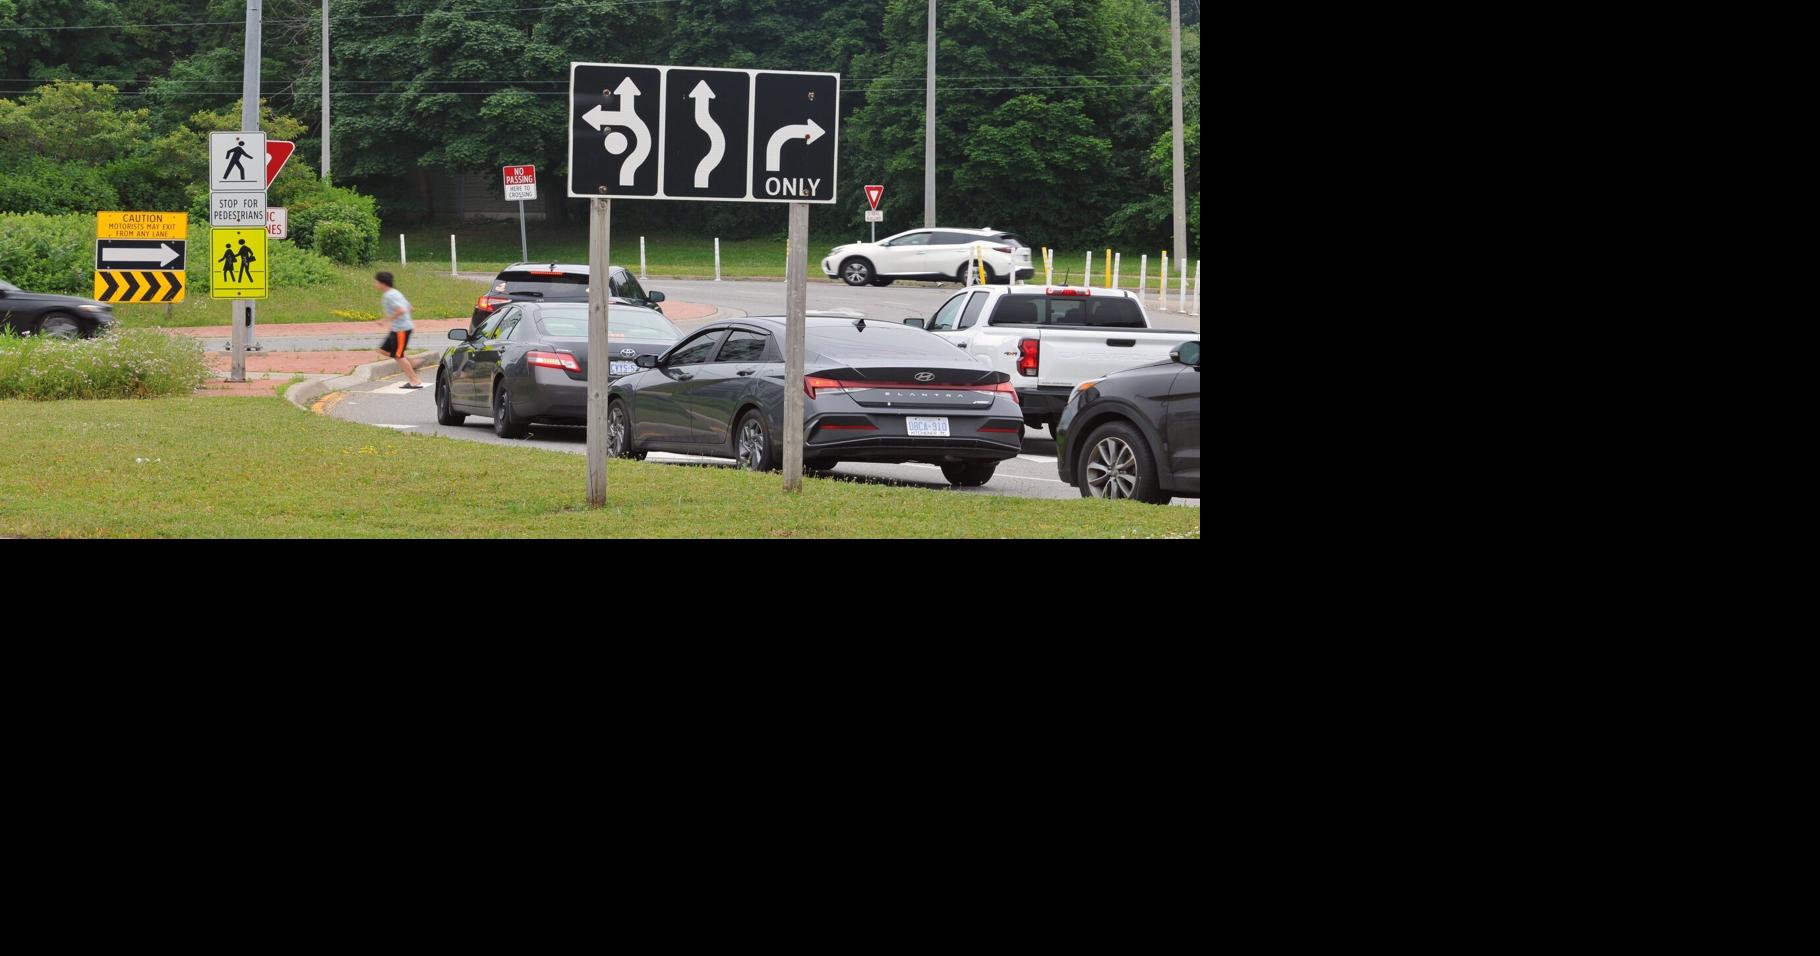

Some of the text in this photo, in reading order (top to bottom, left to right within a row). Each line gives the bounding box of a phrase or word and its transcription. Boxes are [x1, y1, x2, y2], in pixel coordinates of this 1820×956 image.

[513, 167, 524, 175] NO
[506, 175, 533, 184] PASSING
[765, 176, 821, 197] ONLY
[219, 199, 258, 208] STOP FOR
[122, 214, 163, 223] CAUTION
[214, 210, 264, 220] PEDESTRIANS
[266, 224, 282, 235] NES
